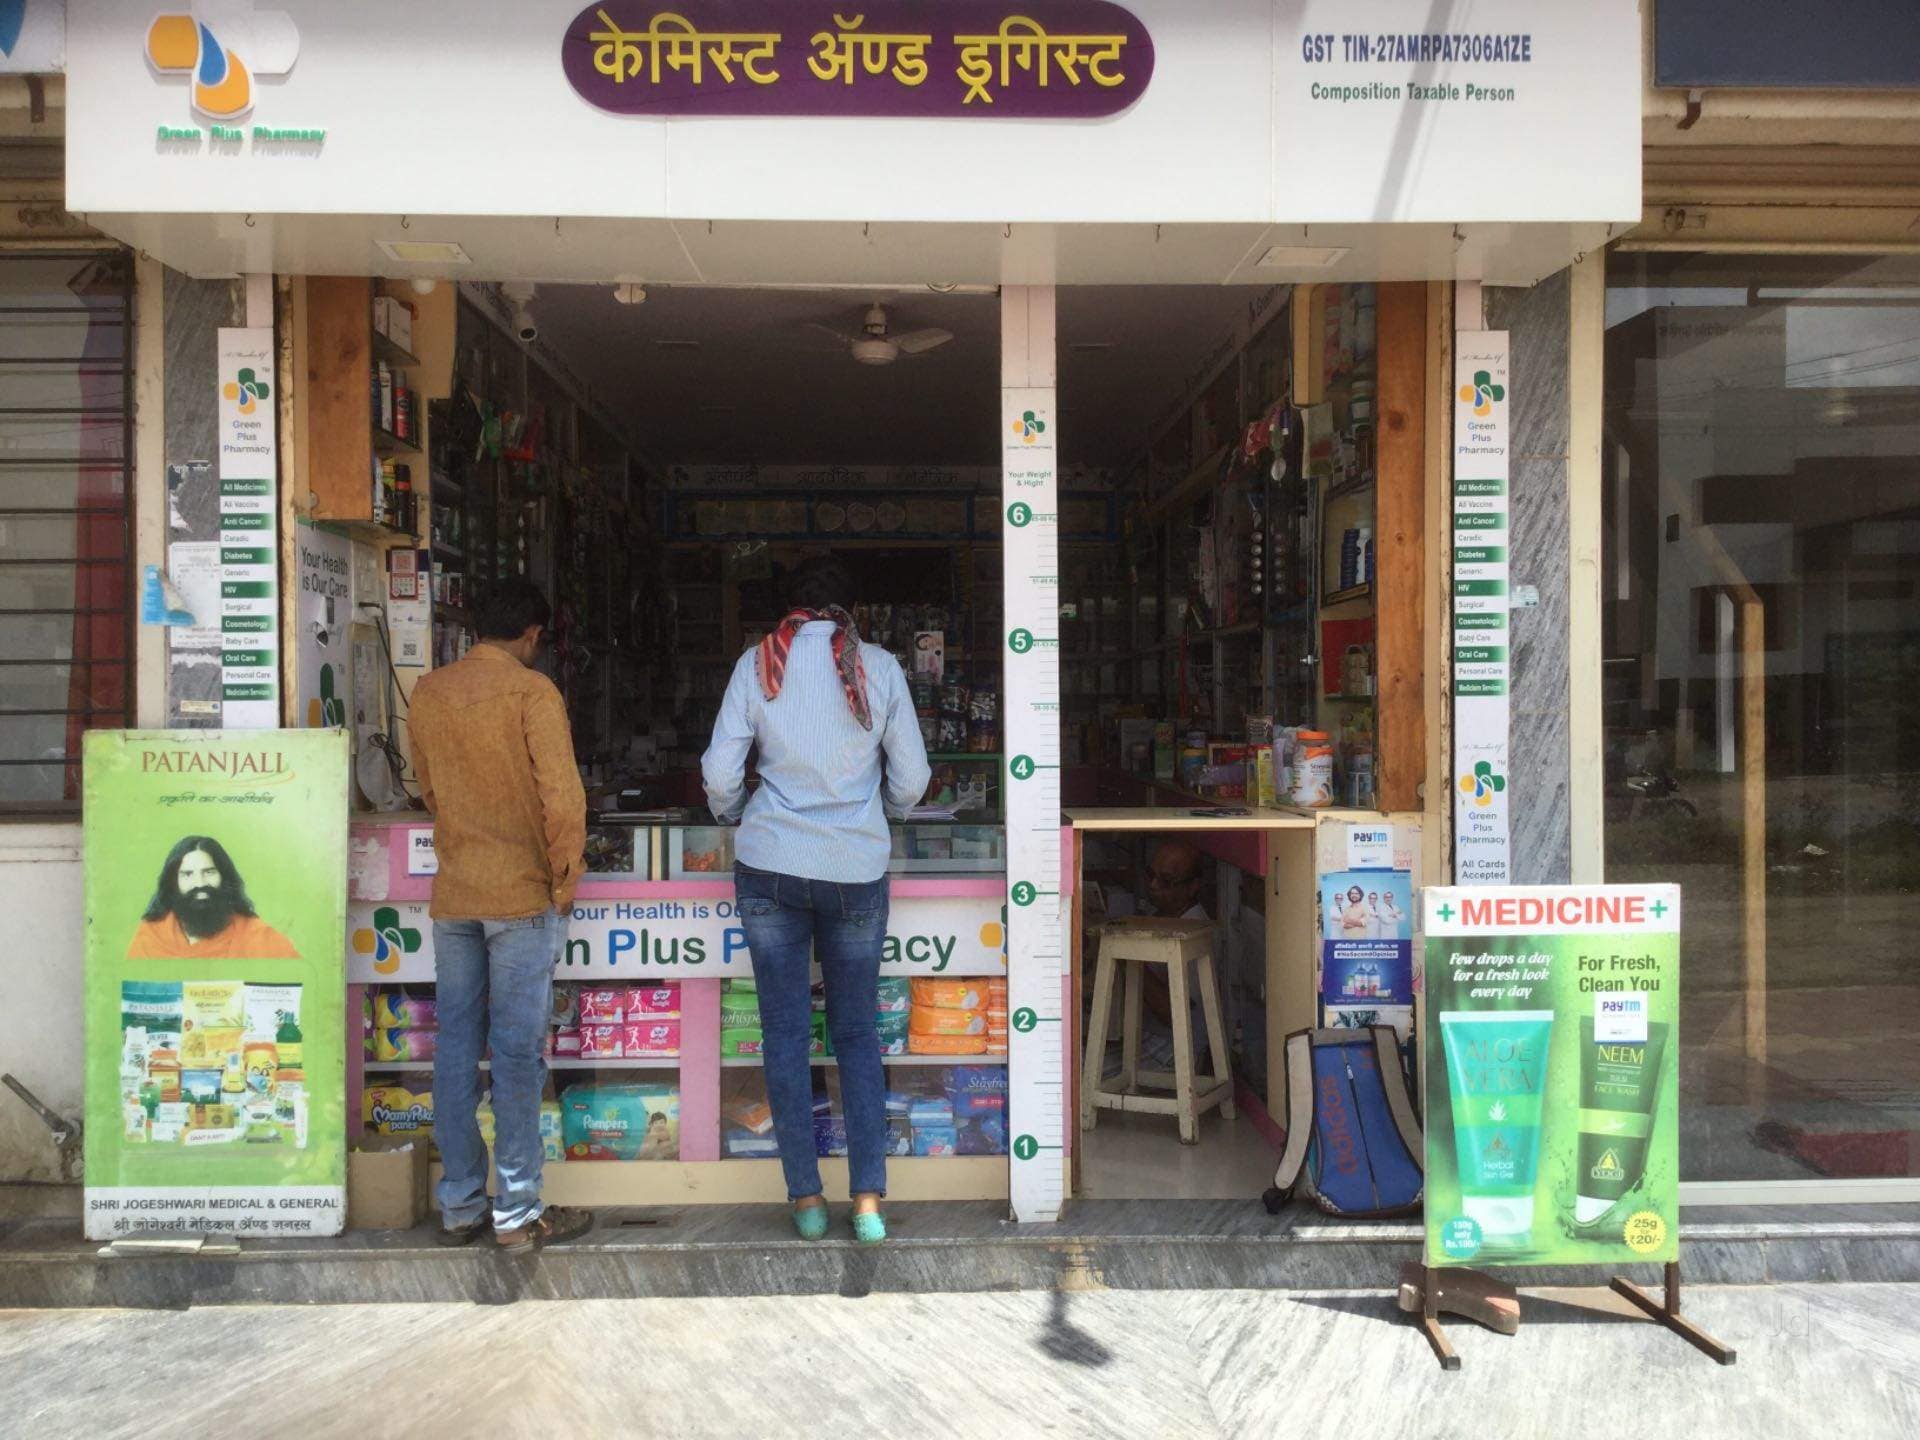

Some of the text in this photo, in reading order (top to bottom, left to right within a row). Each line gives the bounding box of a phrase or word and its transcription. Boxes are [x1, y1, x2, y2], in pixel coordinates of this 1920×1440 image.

[1302, 34, 1531, 63] GST TIN-27AMRPA7306A1ZE
[589, 9, 781, 84] केमिस्ट
[953, 15, 1127, 104] ड्रगिस्ट
[1311, 82, 1515, 103] Composition Taxable Person
[232, 420, 262, 429] Green
[1467, 422, 1496, 430] Green
[237, 432, 257, 441] Plus
[1472, 434, 1491, 442] Plus
[223, 444, 271, 455] Pharmacy
[1458, 446, 1505, 456] Pharmacy
[1008, 471, 1052, 480] Your Weight
[1458, 484, 1500, 492] All Medicines
[1012, 505, 1025, 524] 6
[1458, 517, 1496, 525] Anti Cancer
[223, 552, 253, 560] Diabetes
[301, 546, 348, 576] Your Health
[1458, 551, 1486, 559] Diabetes
[224, 586, 237, 594] HIV
[302, 571, 348, 598] is Our Care
[1458, 584, 1470, 592] HIV
[225, 603, 252, 611] Surgical
[1458, 601, 1485, 609] Surgical
[225, 637, 259, 646] Baby Care
[1014, 632, 1027, 650] 5
[1458, 634, 1491, 643] Baby Care
[225, 654, 257, 662] Oral Care
[256, 671, 271, 679] Care
[142, 751, 283, 778] PATANJALI
[1015, 758, 1028, 777] 4
[1468, 812, 1497, 820] Green
[1473, 824, 1493, 832] Plus
[1460, 835, 1506, 845] Pharmacy
[1462, 859, 1506, 868] All Cards
[1461, 871, 1506, 881] Accepted
[1017, 885, 1028, 902] 3
[572, 906, 610, 920] our
[615, 902, 685, 920] Health
[692, 902, 709, 918] is
[1460, 896, 1645, 926] MEDICINE
[608, 928, 707, 966] Plus
[1450, 951, 1553, 967] Few drops a day
[1578, 954, 1661, 972] For Fresh,
[1453, 968, 1549, 982] for a fresh look
[1579, 975, 1660, 992] Clean You
[1470, 985, 1532, 999] every day
[1018, 1012, 1030, 1029] 2
[1464, 1038, 1532, 1062] ALOE
[1598, 1045, 1644, 1065] NEEM
[1462, 1066, 1534, 1091] VERA
[583, 1114, 628, 1131] Pampers
[1021, 1138, 1029, 1156] 1
[1483, 1160, 1514, 1170] Herbal
[90, 1198, 338, 1210] SHRI JOGESHWARI MEDICAL & GENERAL
[114, 1216, 131, 1232] श्री
[1633, 1219, 1657, 1232] 25g
